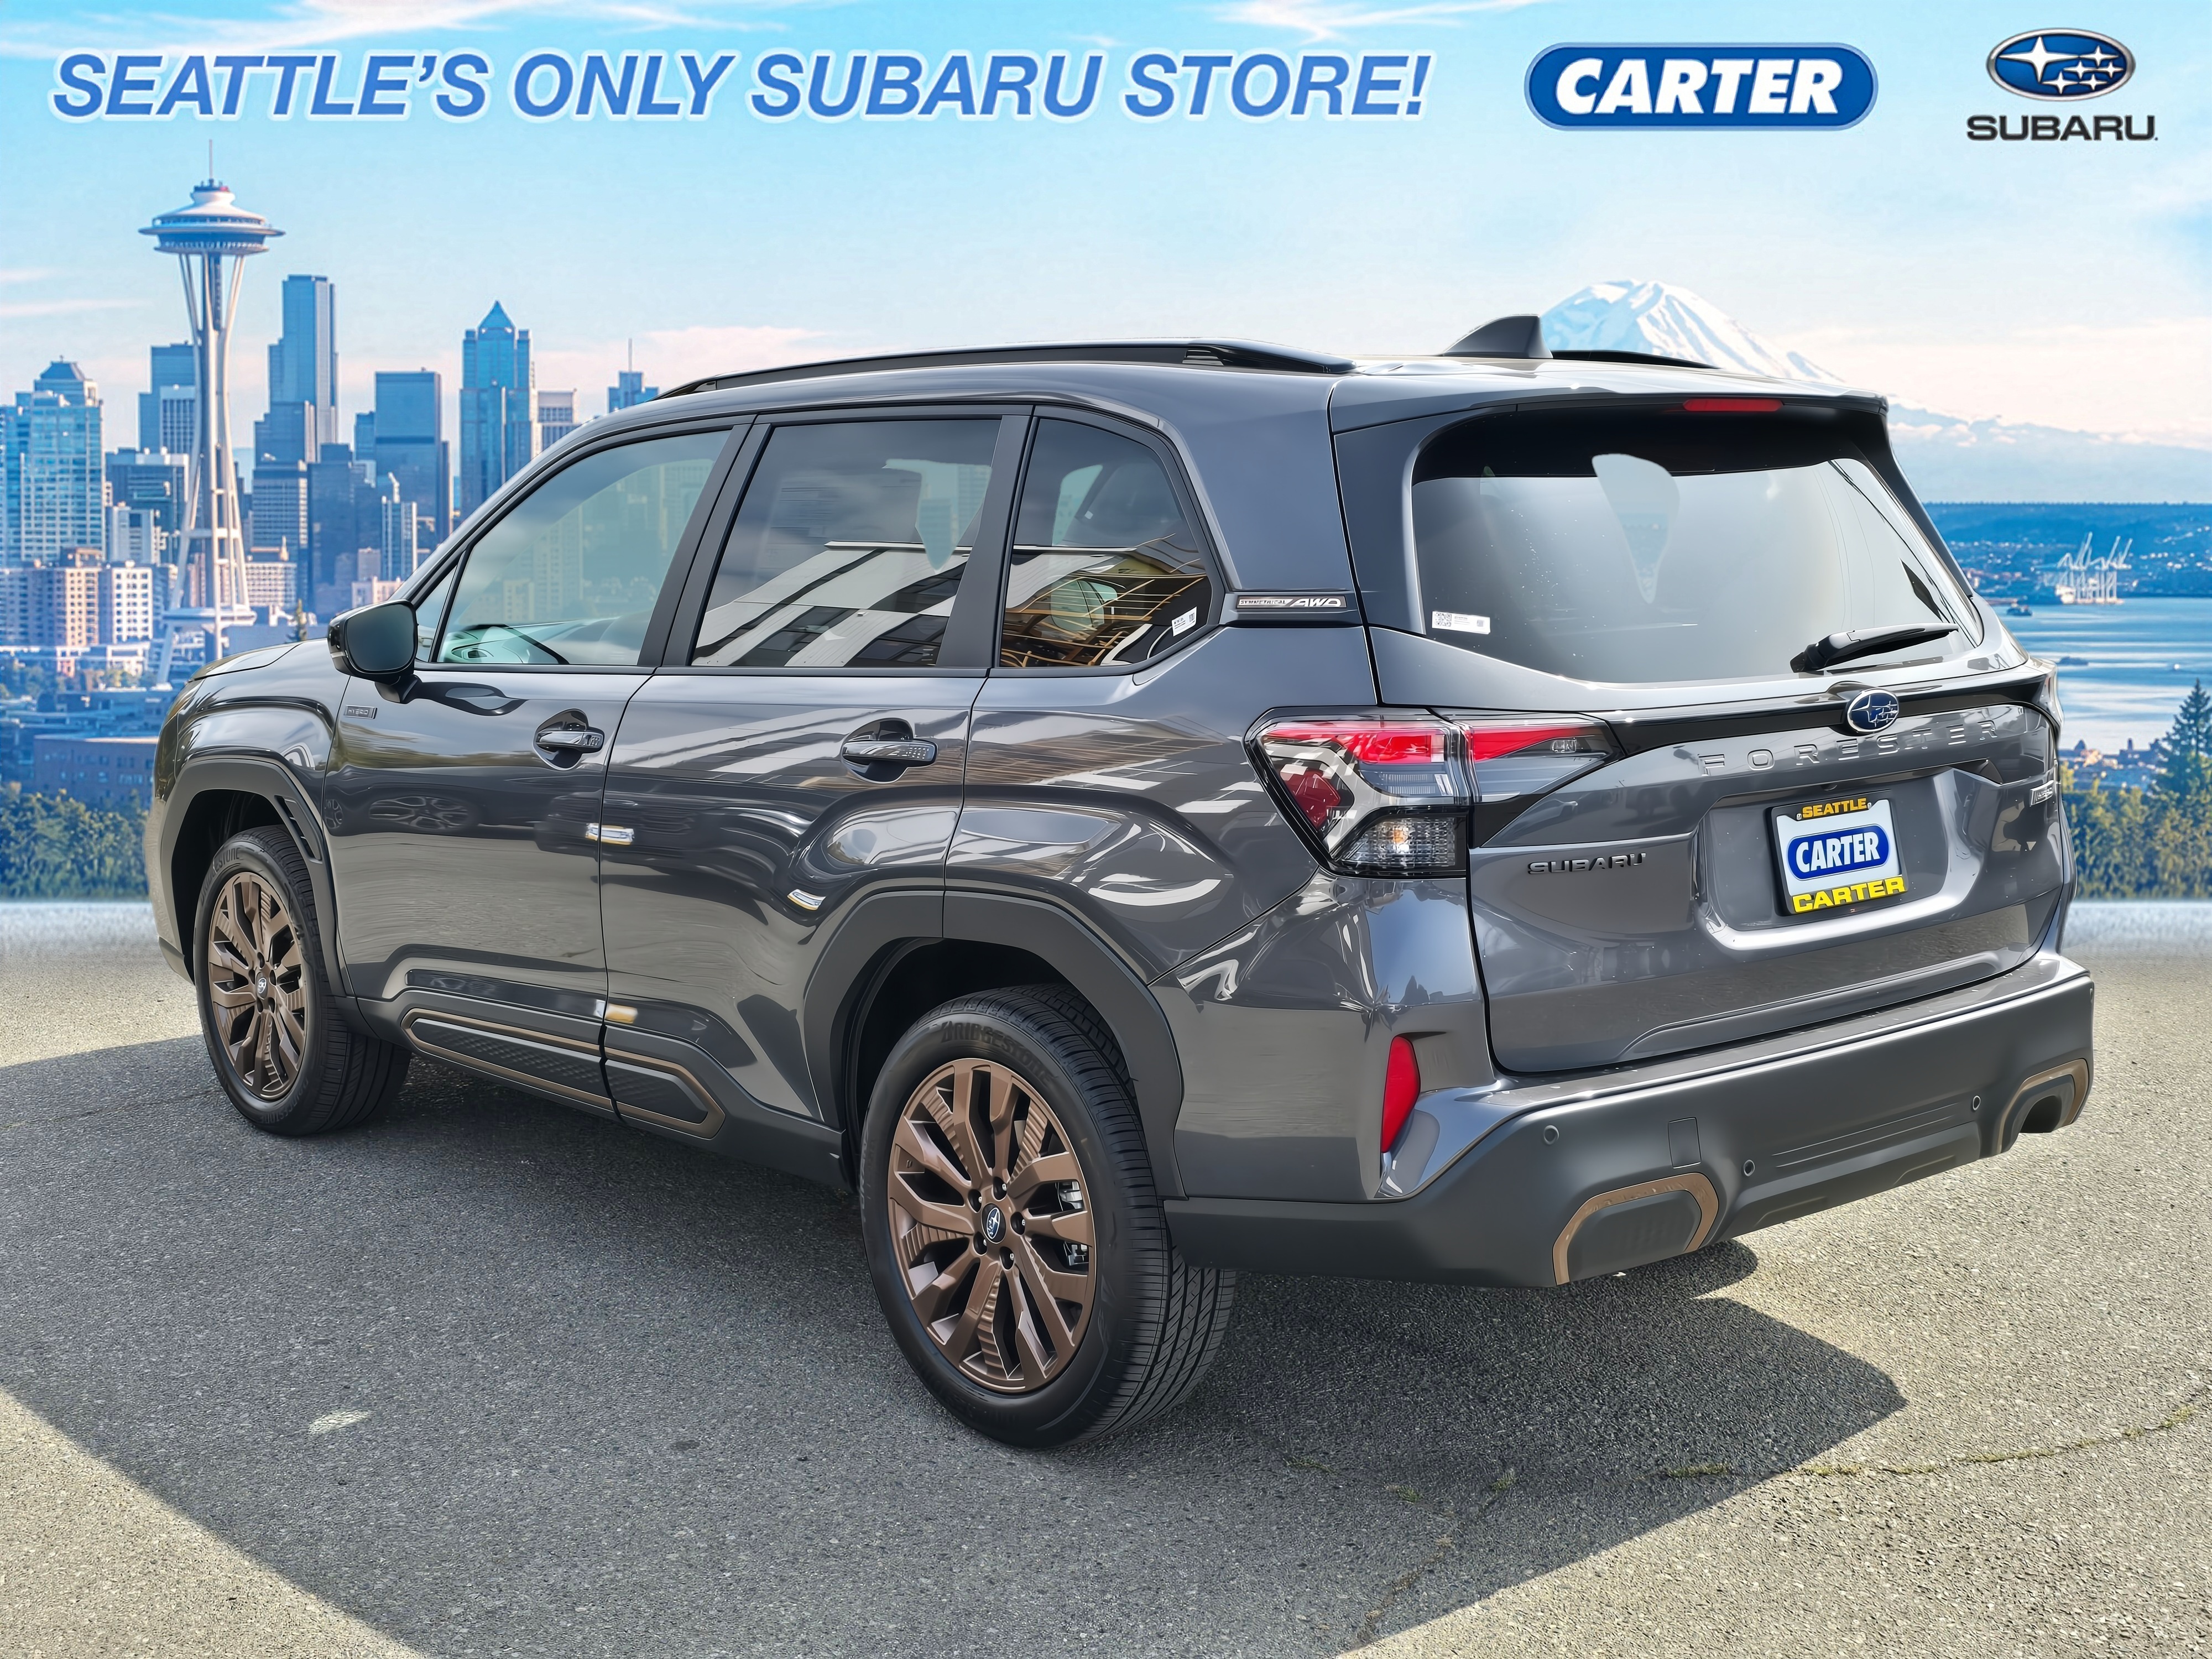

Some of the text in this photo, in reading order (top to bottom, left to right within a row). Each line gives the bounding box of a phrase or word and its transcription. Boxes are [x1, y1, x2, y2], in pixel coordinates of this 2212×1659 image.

[1290, 598, 1342, 607] AWD
[1698, 719, 1998, 776] FORESTER
[1802, 797, 1867, 819] SEATTLE
[1527, 852, 1646, 875] SUBARU
[1796, 831, 1881, 873] CARTER
[1792, 876, 1906, 912] CARTER
